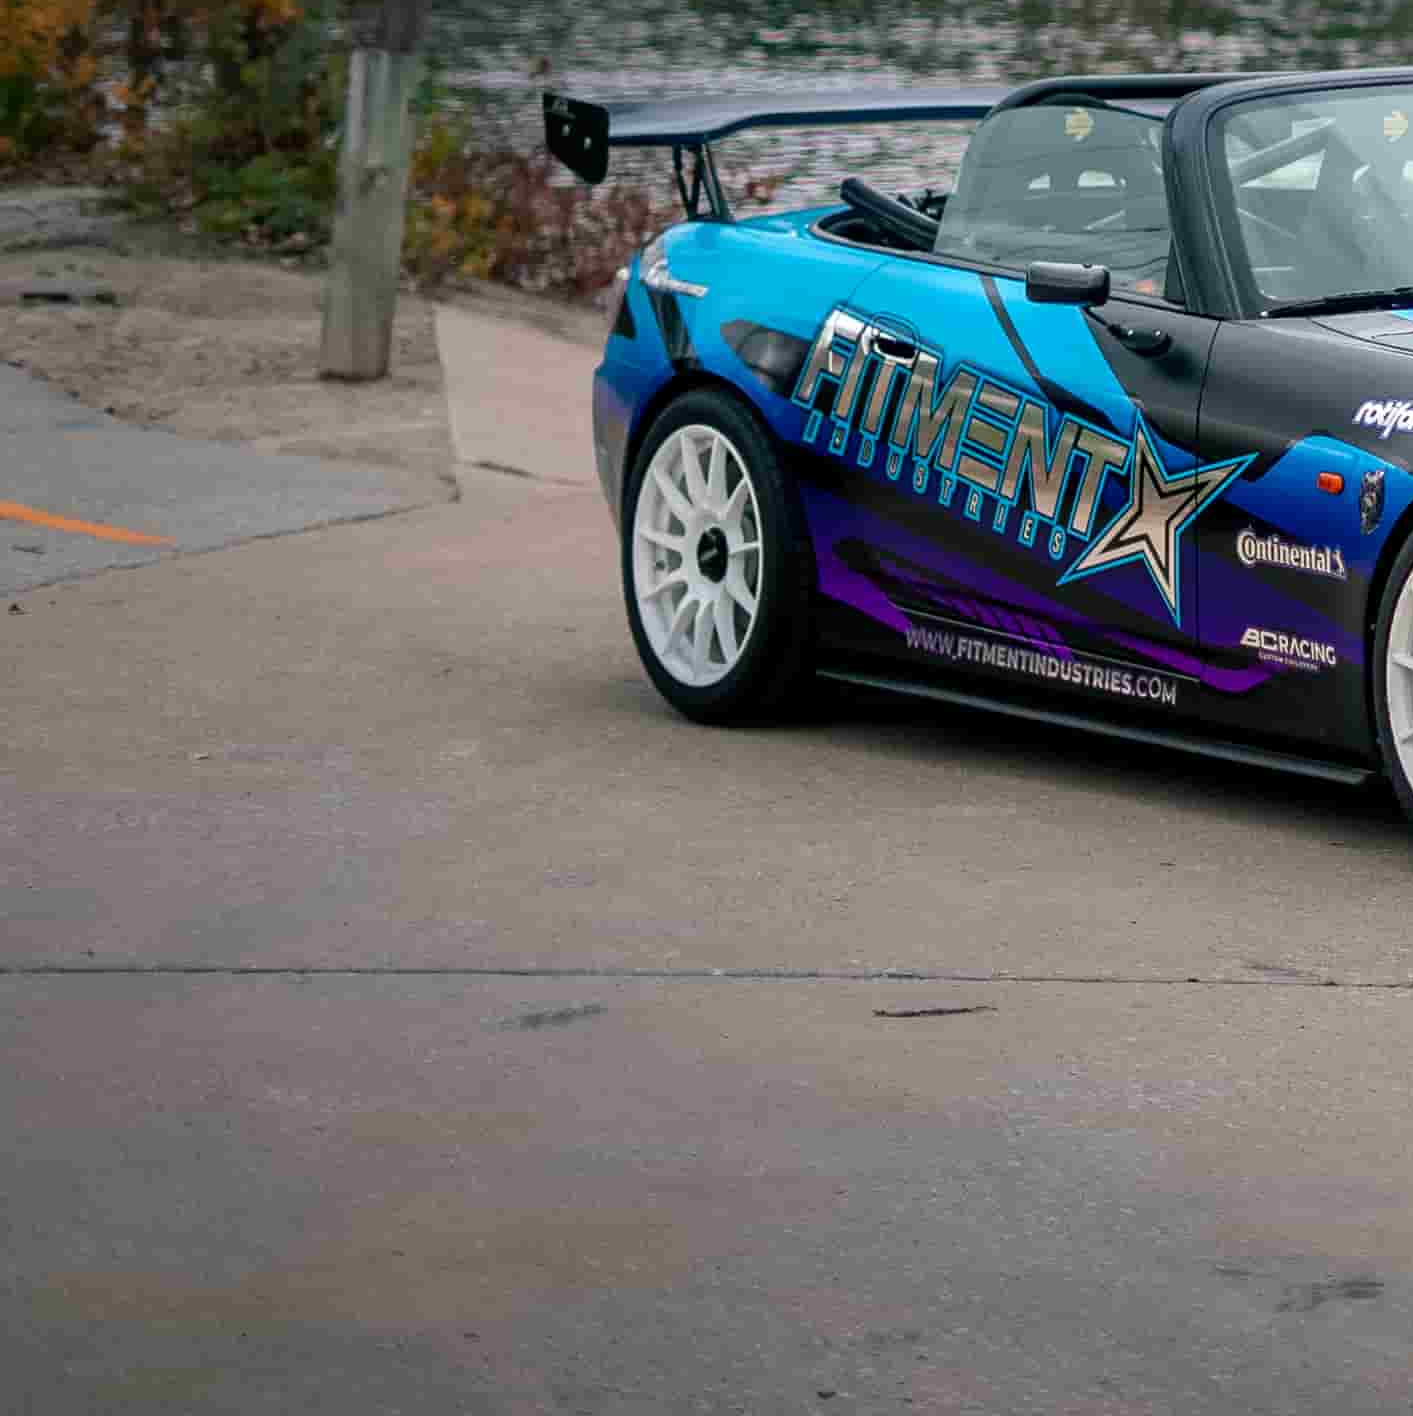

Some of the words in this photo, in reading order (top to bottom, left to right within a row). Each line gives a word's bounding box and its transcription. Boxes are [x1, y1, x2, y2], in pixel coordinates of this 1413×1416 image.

[791, 302, 1132, 543] FITMENT
[803, 410, 1070, 560] INDUSTRIES
[1237, 526, 1332, 574] Continental
[904, 626, 1178, 705] WWW.FITMENTINDUSTRIES.COM
